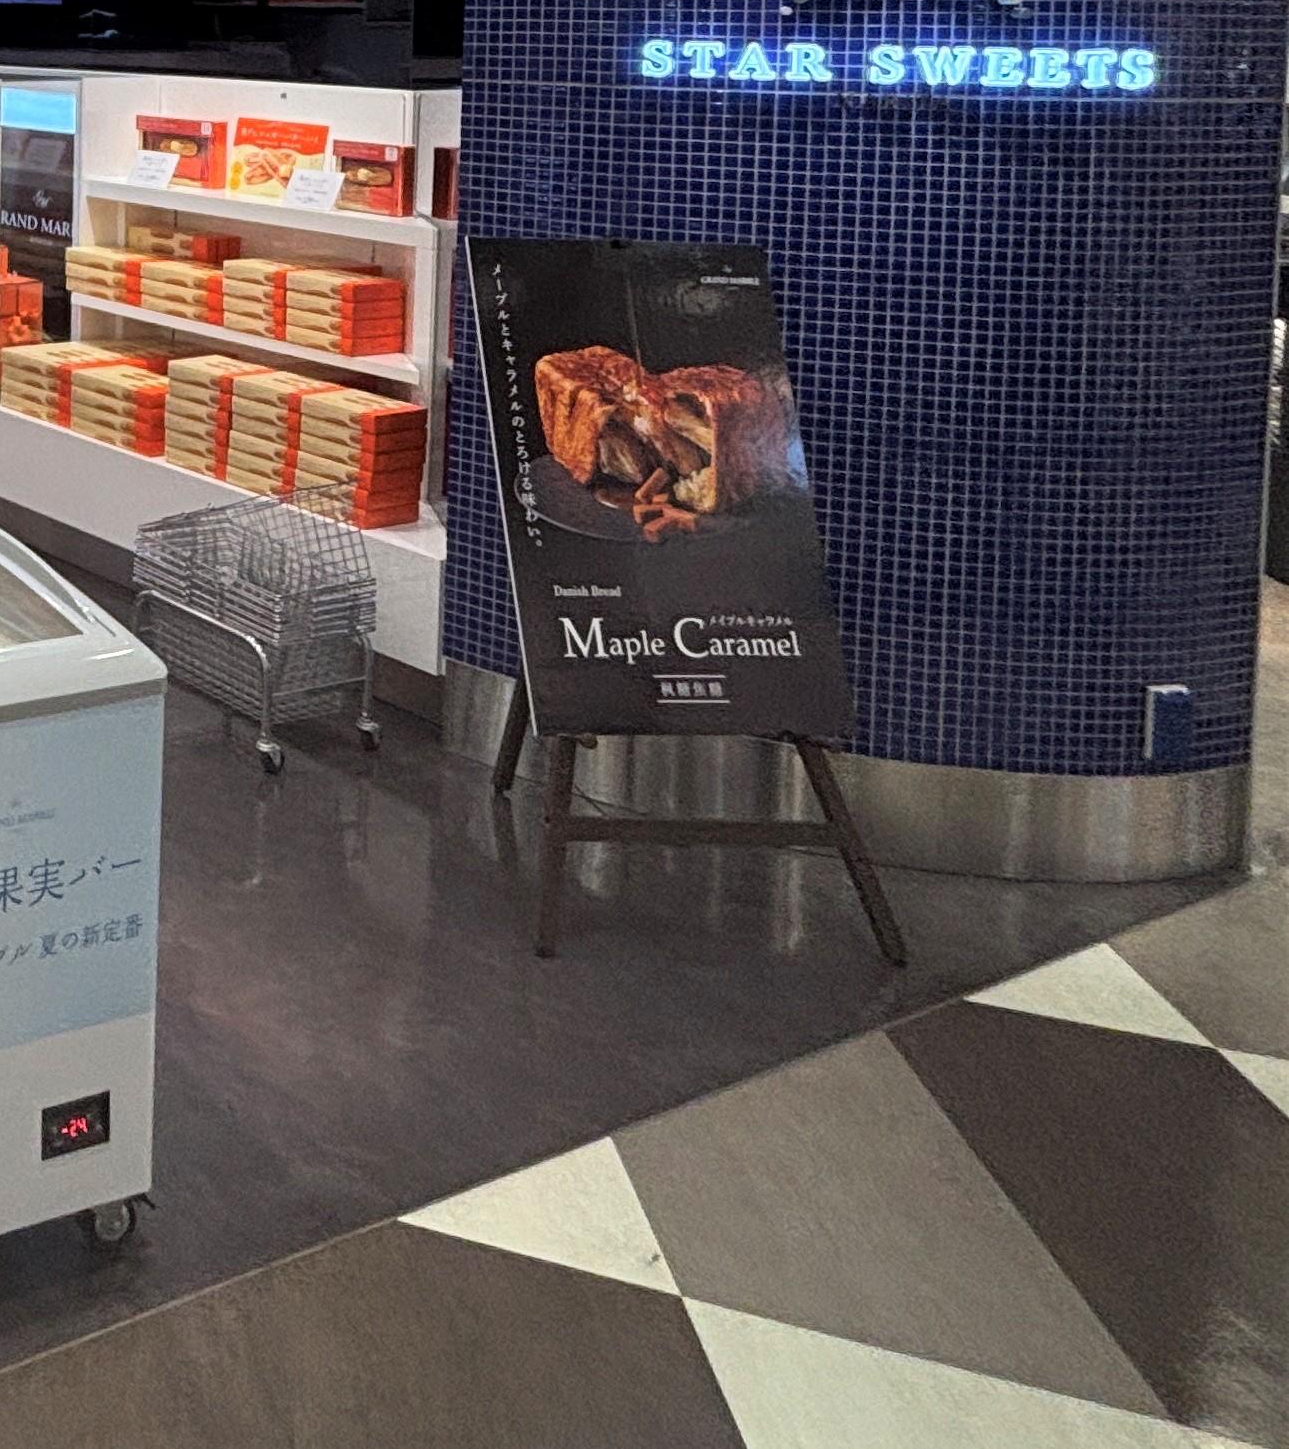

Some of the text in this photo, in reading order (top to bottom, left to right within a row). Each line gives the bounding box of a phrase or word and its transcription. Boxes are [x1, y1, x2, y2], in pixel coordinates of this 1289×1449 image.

[641, 39, 1155, 91] STAR SWEETS
[0, 209, 72, 237] RAND MAR
[553, 585, 622, 597] Danish Bread
[558, 616, 803, 665] Maple Caramel
[39, 912, 144, 959] 夏の新定番
[61, 1117, 88, 1138] -24
